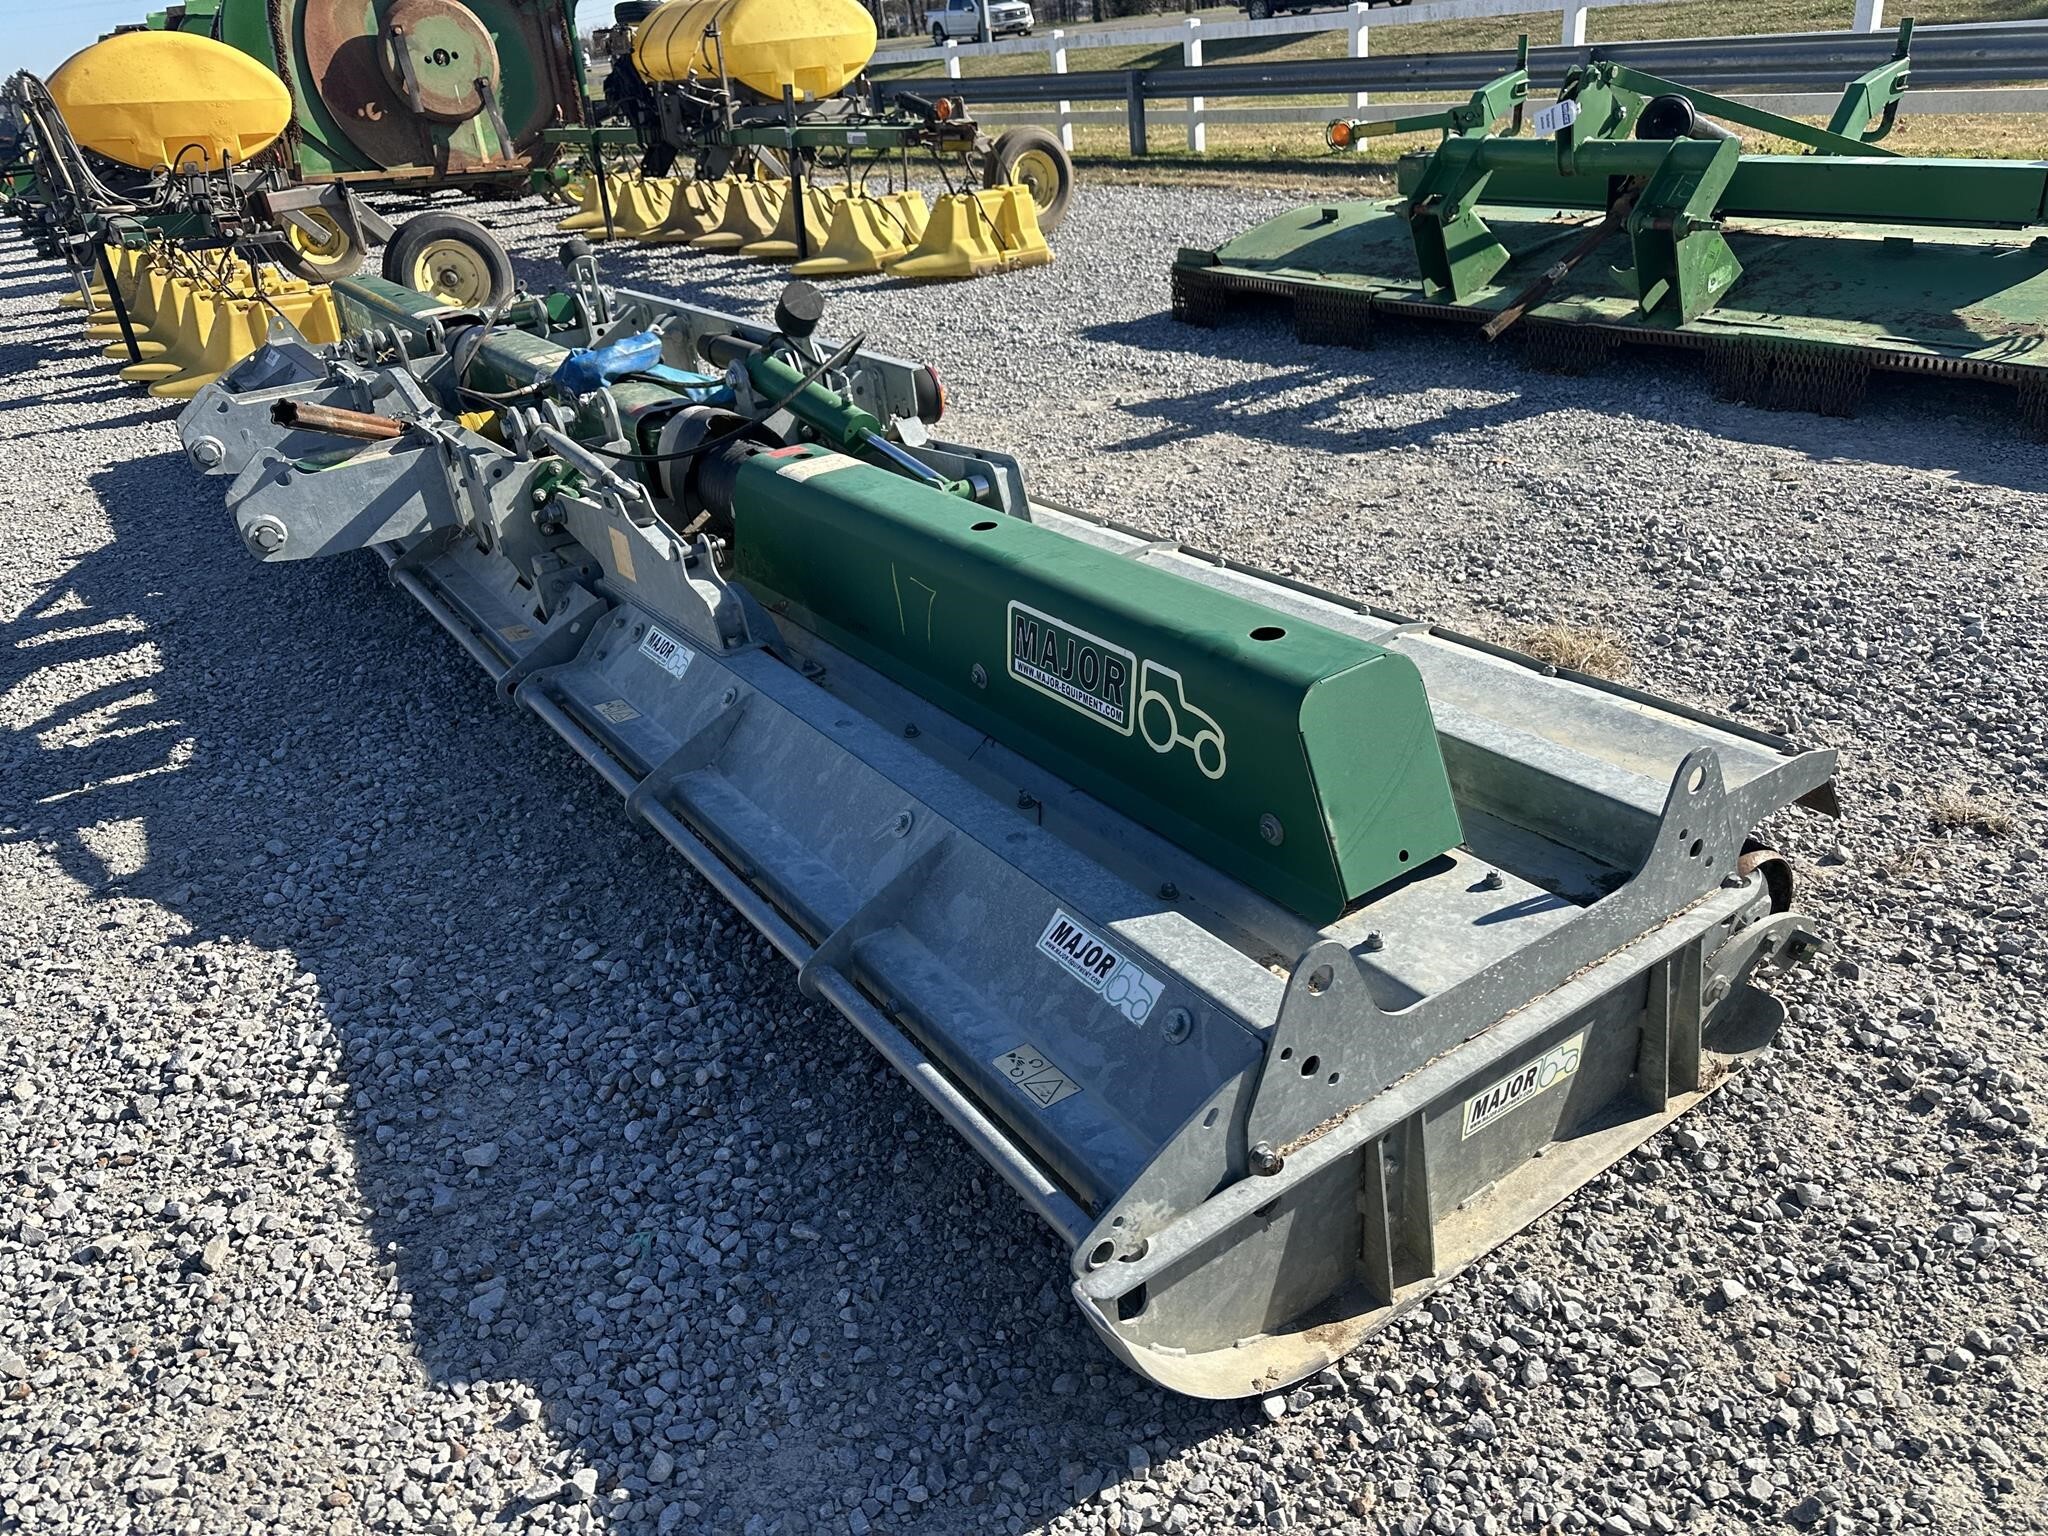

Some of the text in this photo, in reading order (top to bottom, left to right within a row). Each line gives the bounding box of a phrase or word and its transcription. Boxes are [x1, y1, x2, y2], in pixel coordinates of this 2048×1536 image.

[891, 562, 937, 645] 17
[648, 632, 676, 660] MAJOR
[1015, 615, 1126, 707] MAJOR
[1017, 661, 1122, 722] WWW.MAJOR-EQUIPMENT.COM
[1049, 920, 1116, 979] MAJOR
[1471, 1066, 1538, 1123] MAJOR
